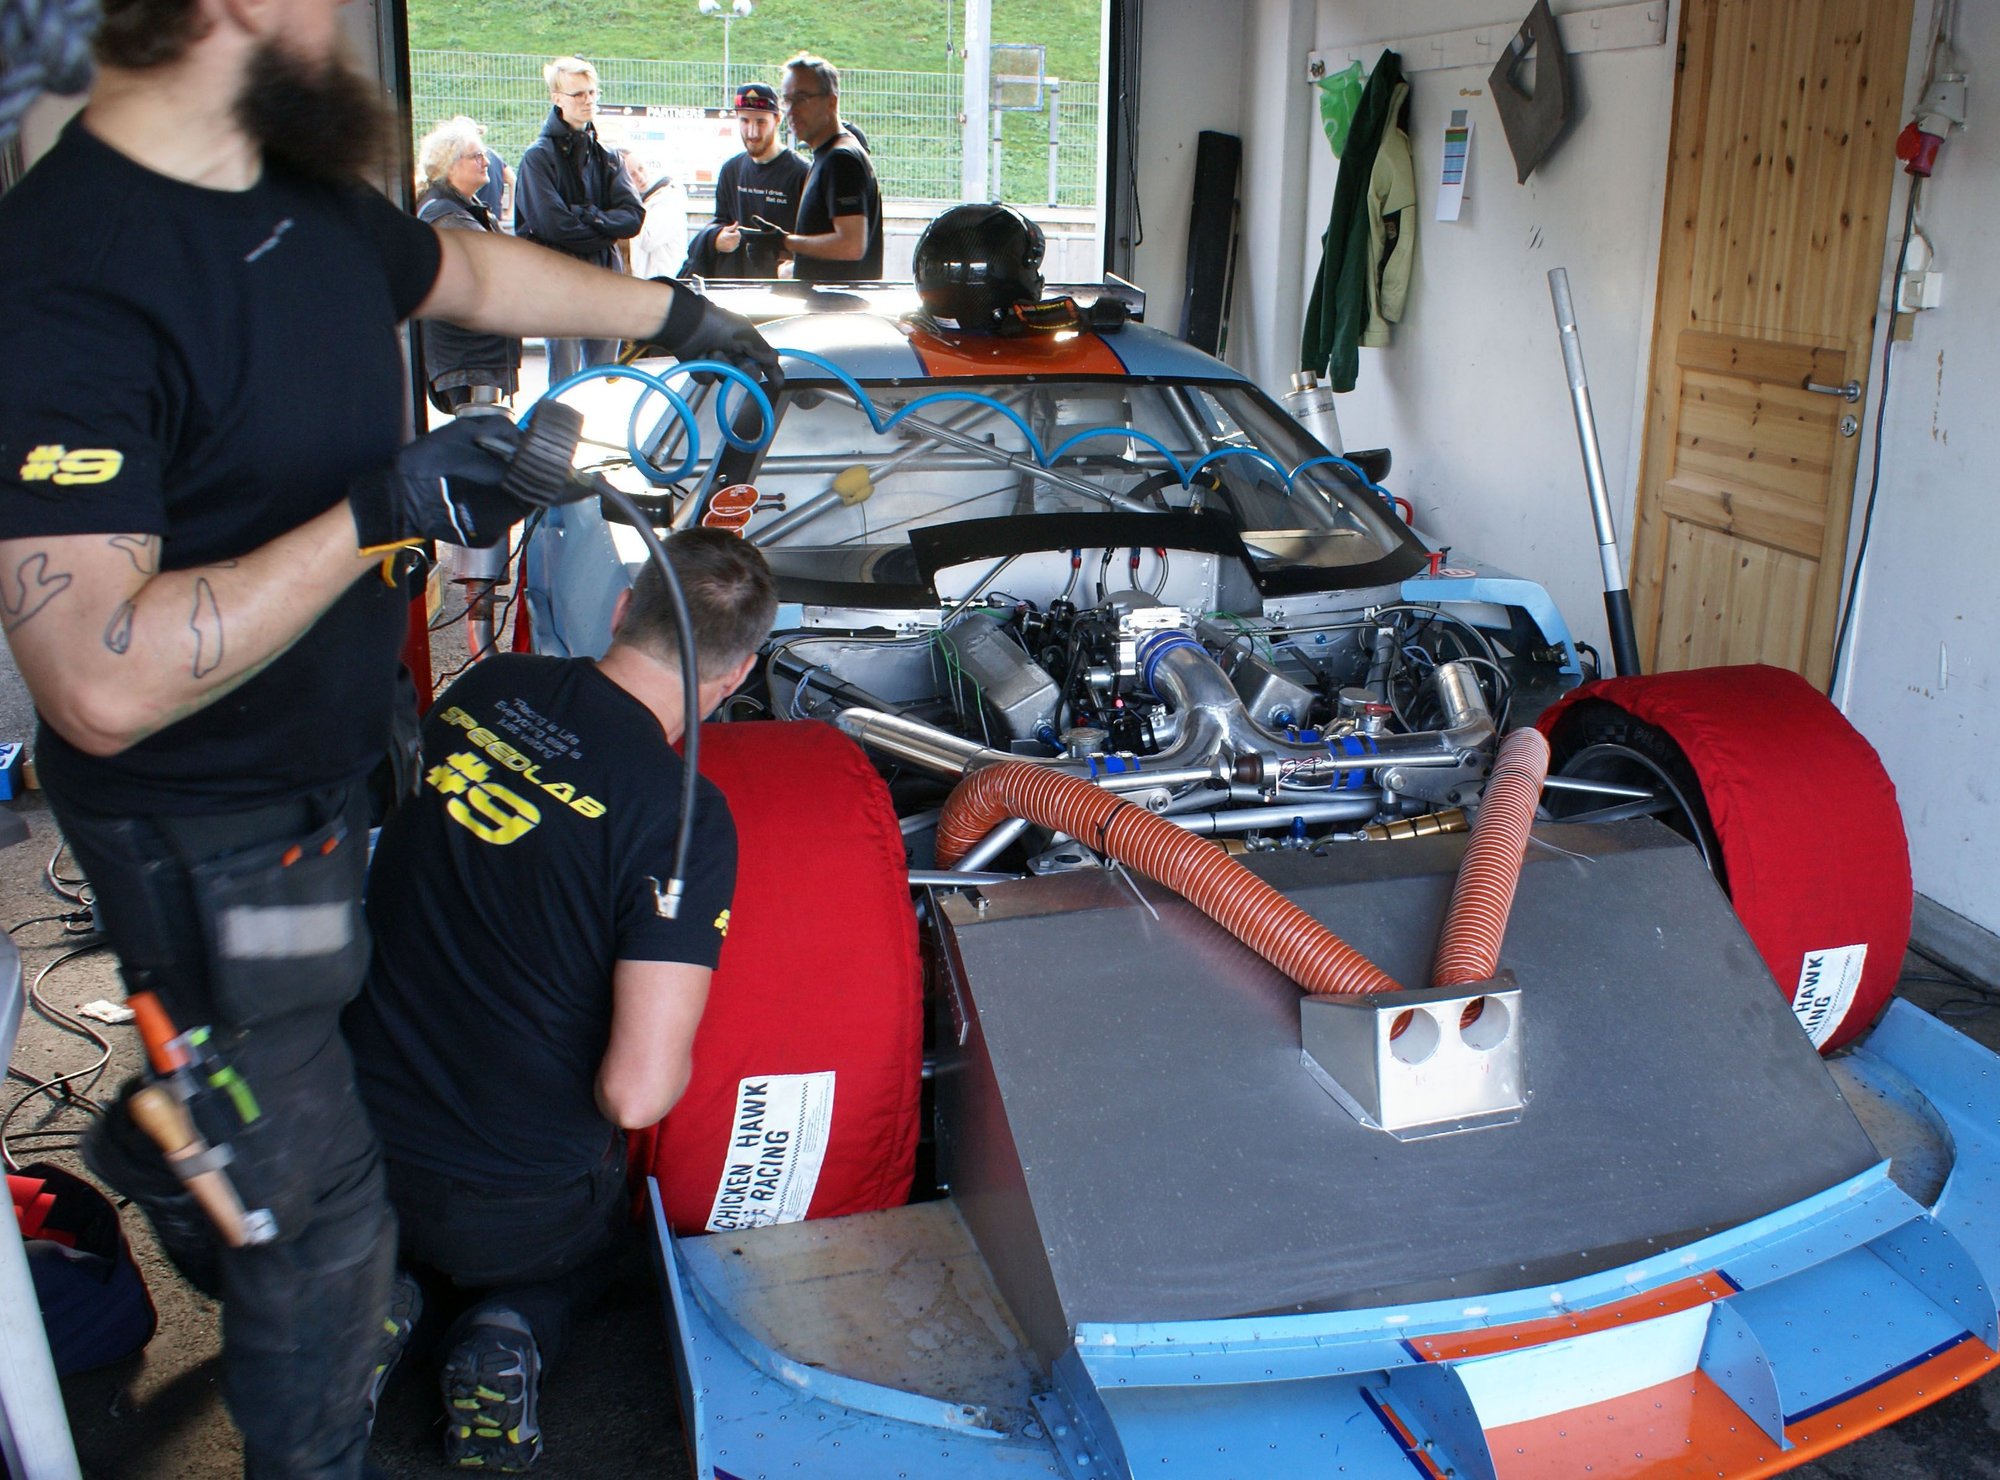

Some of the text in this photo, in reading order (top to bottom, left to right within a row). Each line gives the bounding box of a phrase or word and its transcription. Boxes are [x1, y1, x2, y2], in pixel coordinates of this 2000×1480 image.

[647, 106, 706, 118] PARTNERS
[20, 444, 124, 485] #9
[494, 700, 584, 760] Everything else is
[496, 716, 522, 735] just
[558, 728, 581, 745] Life
[439, 706, 607, 819] SPEEDLAB
[425, 751, 542, 845] #9
[1796, 956, 1824, 1013] HAWK
[713, 1082, 768, 1229] CHICKEN HAWK
[751, 1130, 790, 1201] RACING
